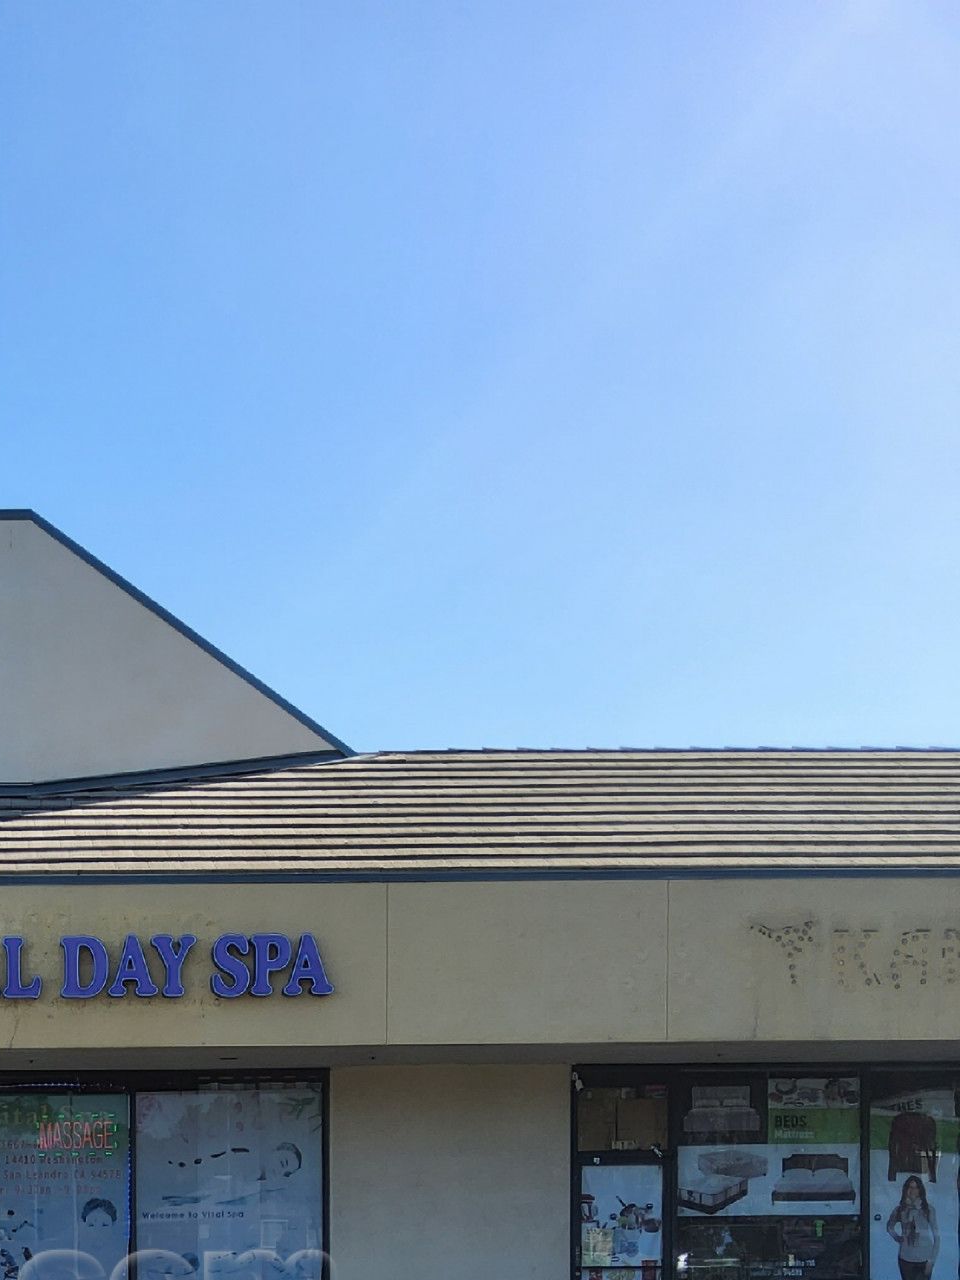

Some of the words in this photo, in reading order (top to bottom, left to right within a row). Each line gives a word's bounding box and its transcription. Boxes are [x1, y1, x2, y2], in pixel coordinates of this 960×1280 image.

[60, 934, 197, 998] DAY
[210, 932, 335, 998] SPA
[39, 1121, 114, 1149] MASSAGE
[774, 1114, 808, 1128] BEDS
